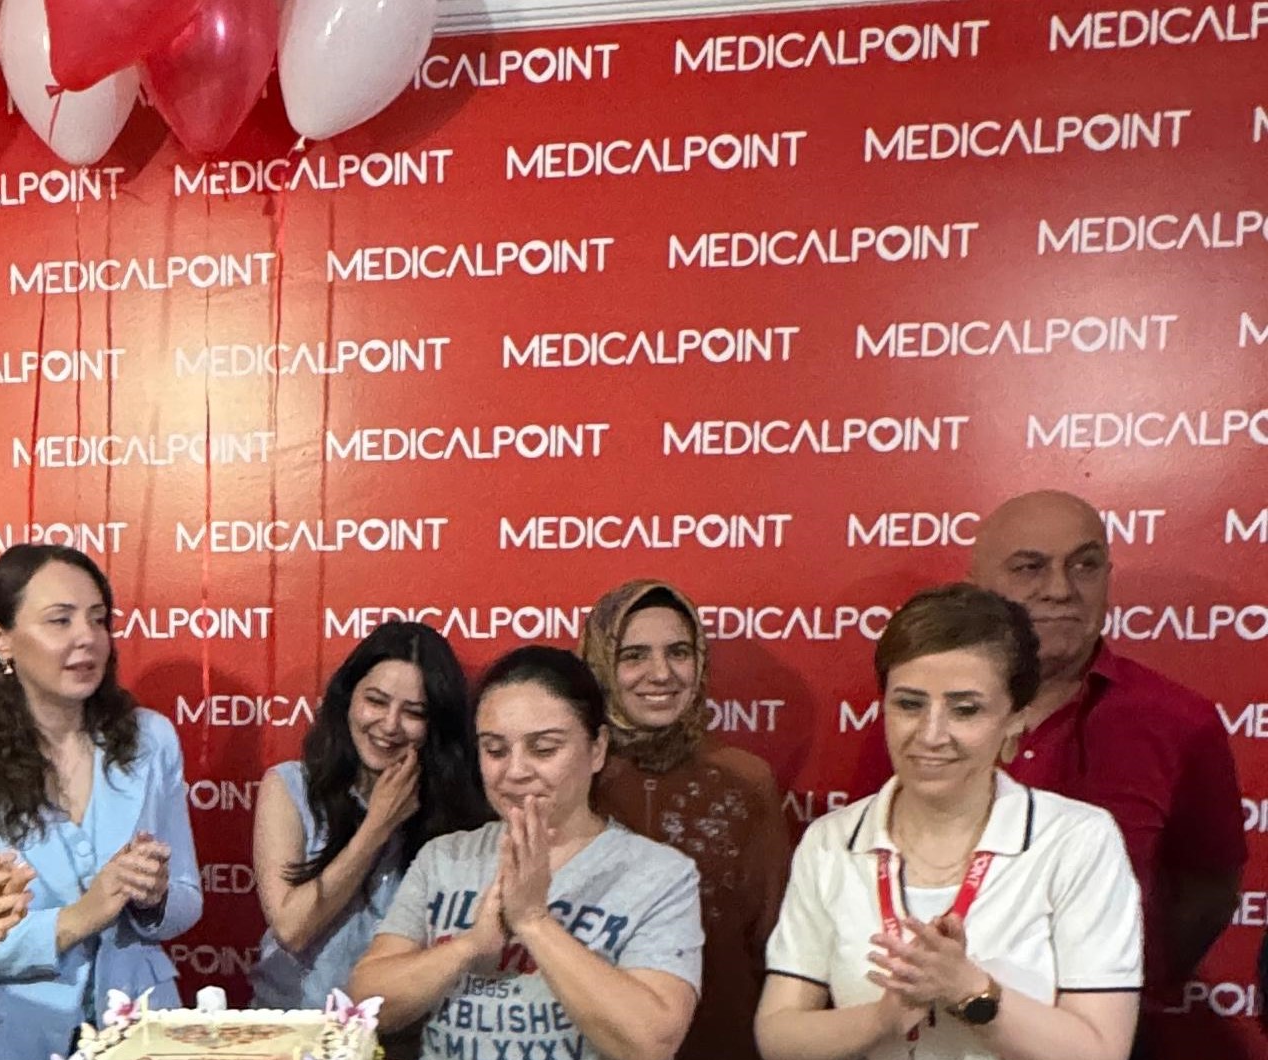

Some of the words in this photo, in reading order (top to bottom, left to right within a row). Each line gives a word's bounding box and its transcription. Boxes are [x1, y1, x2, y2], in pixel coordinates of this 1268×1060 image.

[675, 20, 990, 74] MEDICALPOINT
[1050, 2, 1268, 51] MEDICALP
[415, 44, 619, 89] ICALPOINT
[507, 131, 807, 179] MEDICALPOINT
[865, 110, 1191, 162] MEDICALPOINT
[175, 149, 453, 196] MEDICALPOINT
[669, 223, 979, 268] MEDICALPOINT
[1038, 211, 1268, 254] MEDICALP
[10, 253, 276, 295] MEDICALPOINT
[328, 238, 614, 281] MEDICALPOINT
[175, 337, 451, 378] MEDICALPOINT
[503, 327, 800, 368] MEDICALPOINT
[856, 315, 1177, 359] MEDICALPOINT
[13, 430, 276, 467] MEDICALPOINT
[326, 423, 609, 461] MEDICALPOINT
[664, 416, 969, 455] MEDICALPOINT
[177, 518, 448, 552] MEDICALPOINT
[500, 514, 792, 549] MEDICALPOINT
[848, 510, 1165, 546] MEDICNT
[698, 606, 890, 640] EDICALPO
[177, 695, 314, 726] MEDICA
[437, 997, 573, 1034] ABLISHE
